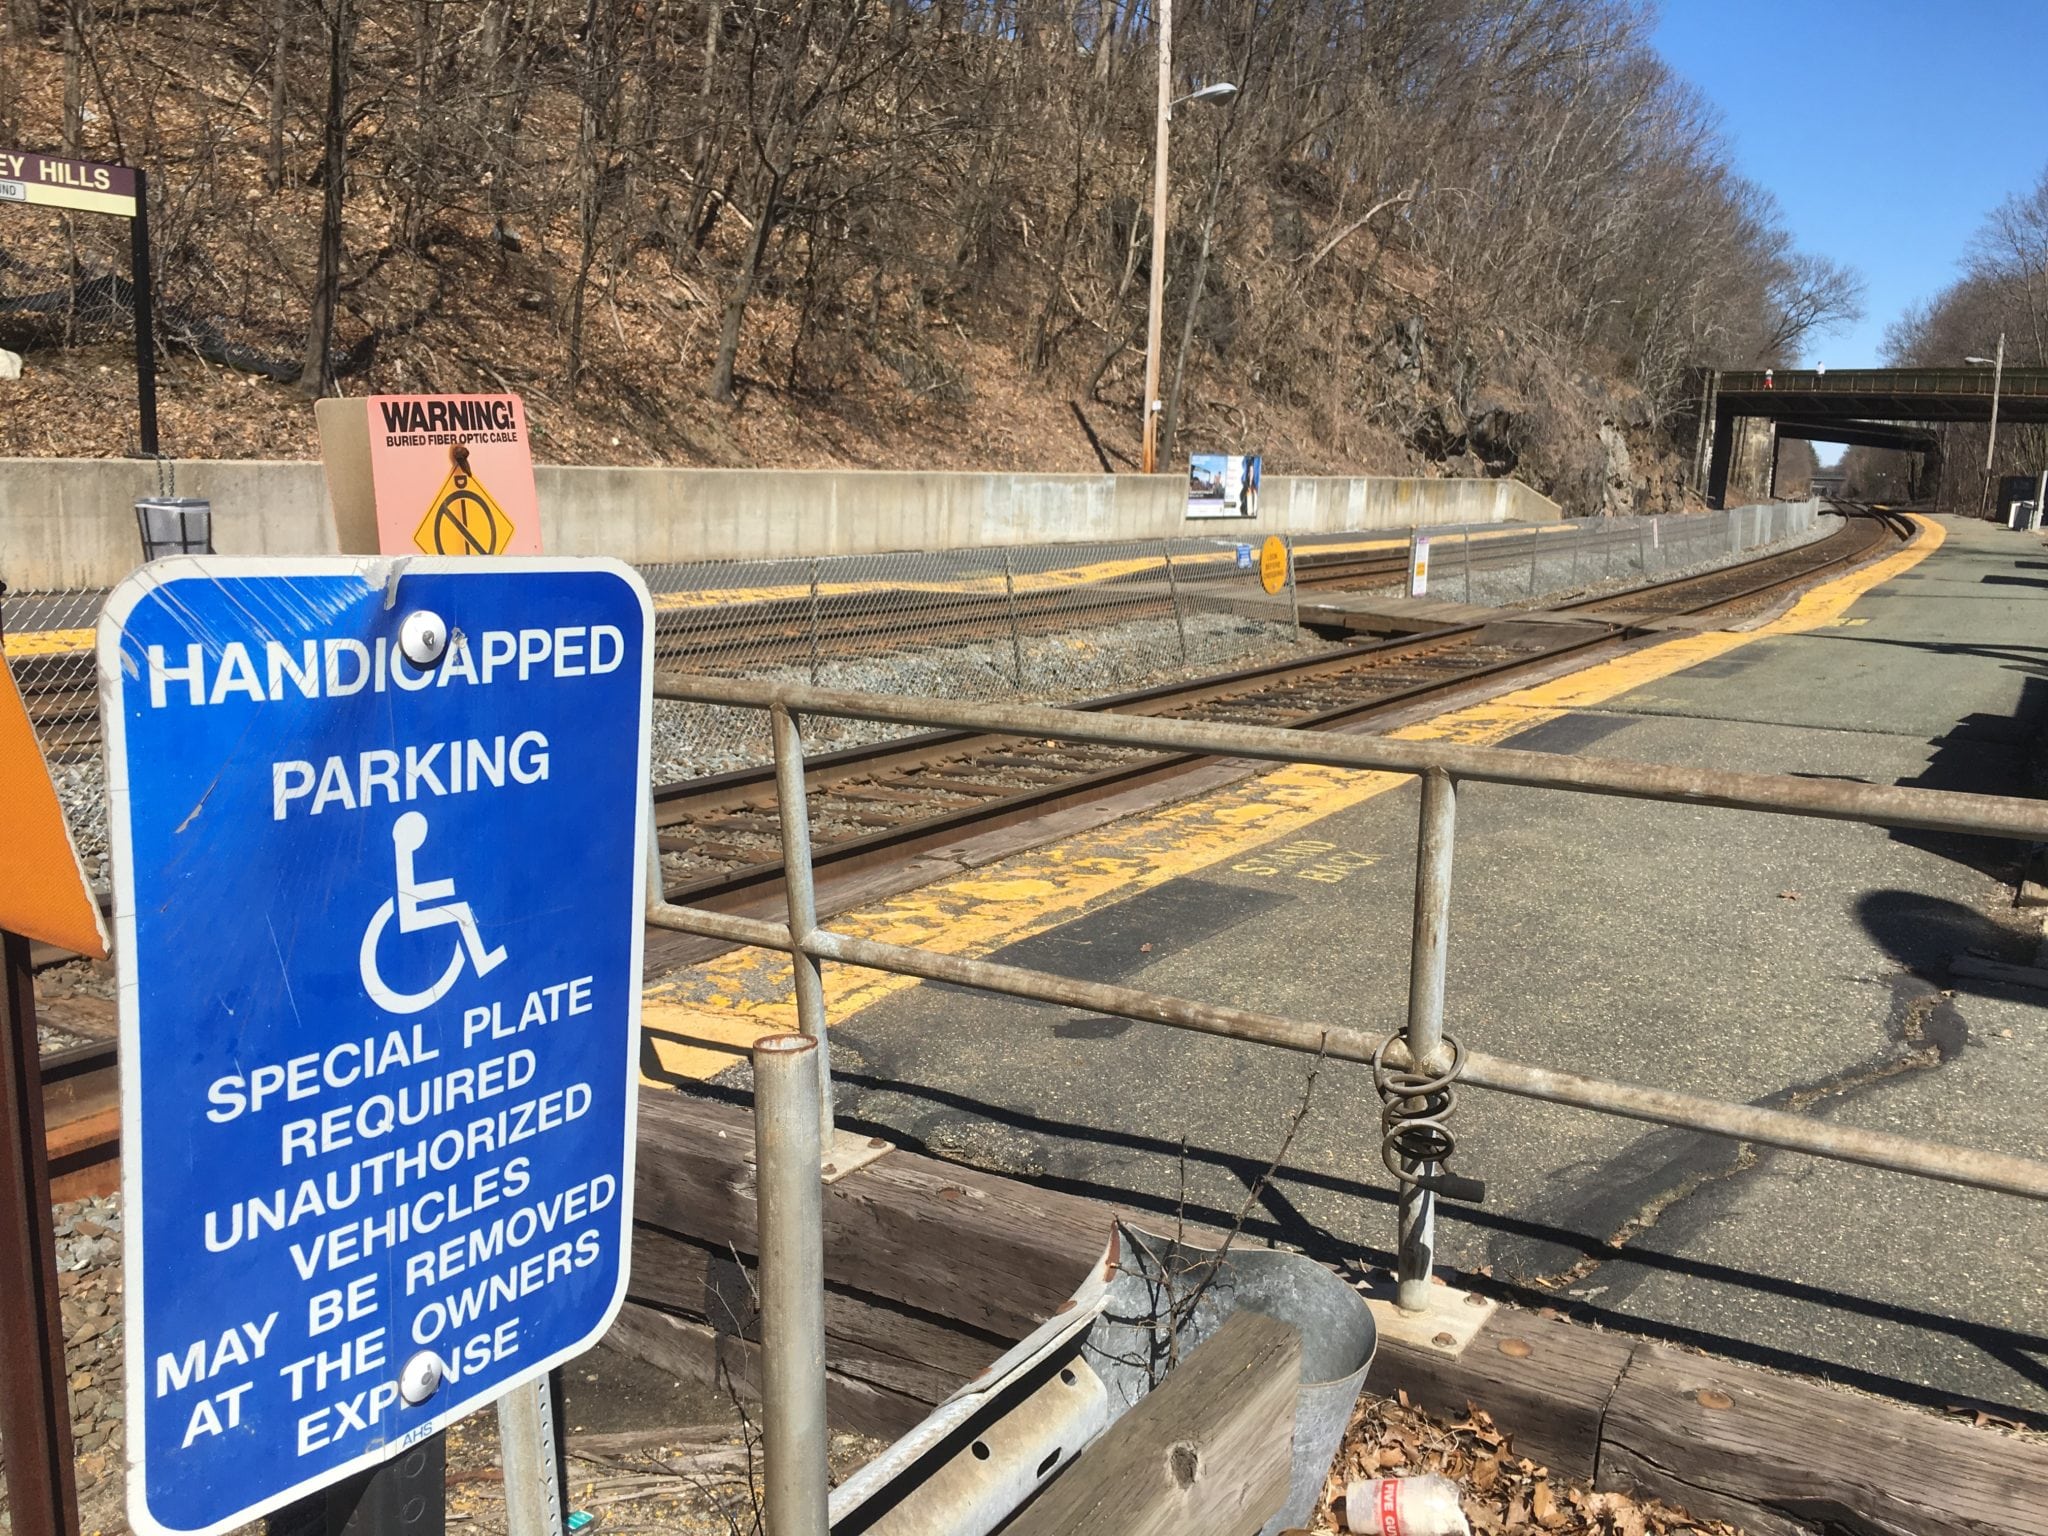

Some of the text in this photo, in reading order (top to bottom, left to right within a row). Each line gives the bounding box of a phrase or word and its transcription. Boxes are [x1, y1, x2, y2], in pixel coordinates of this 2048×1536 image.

[39, 159, 111, 190] HILLS
[380, 400, 516, 433] WARNING!
[386, 431, 518, 447] BURIED FIBER OPTIC CABLE
[272, 731, 550, 821] PARKING
[206, 975, 594, 1125] SPECIAL PLATE
[281, 1049, 537, 1167] REQUIRED
[204, 1082, 593, 1253] UNAUTHORIZED
[289, 1156, 531, 1281] VEHICLES
[155, 1173, 617, 1399] MAY BE REMOVED
[180, 1228, 601, 1449] AT THE OWNERS
[296, 1317, 520, 1457] EXPNSE
[402, 1421, 434, 1448] AHS
[1383, 1483, 1395, 1512] FIVE
